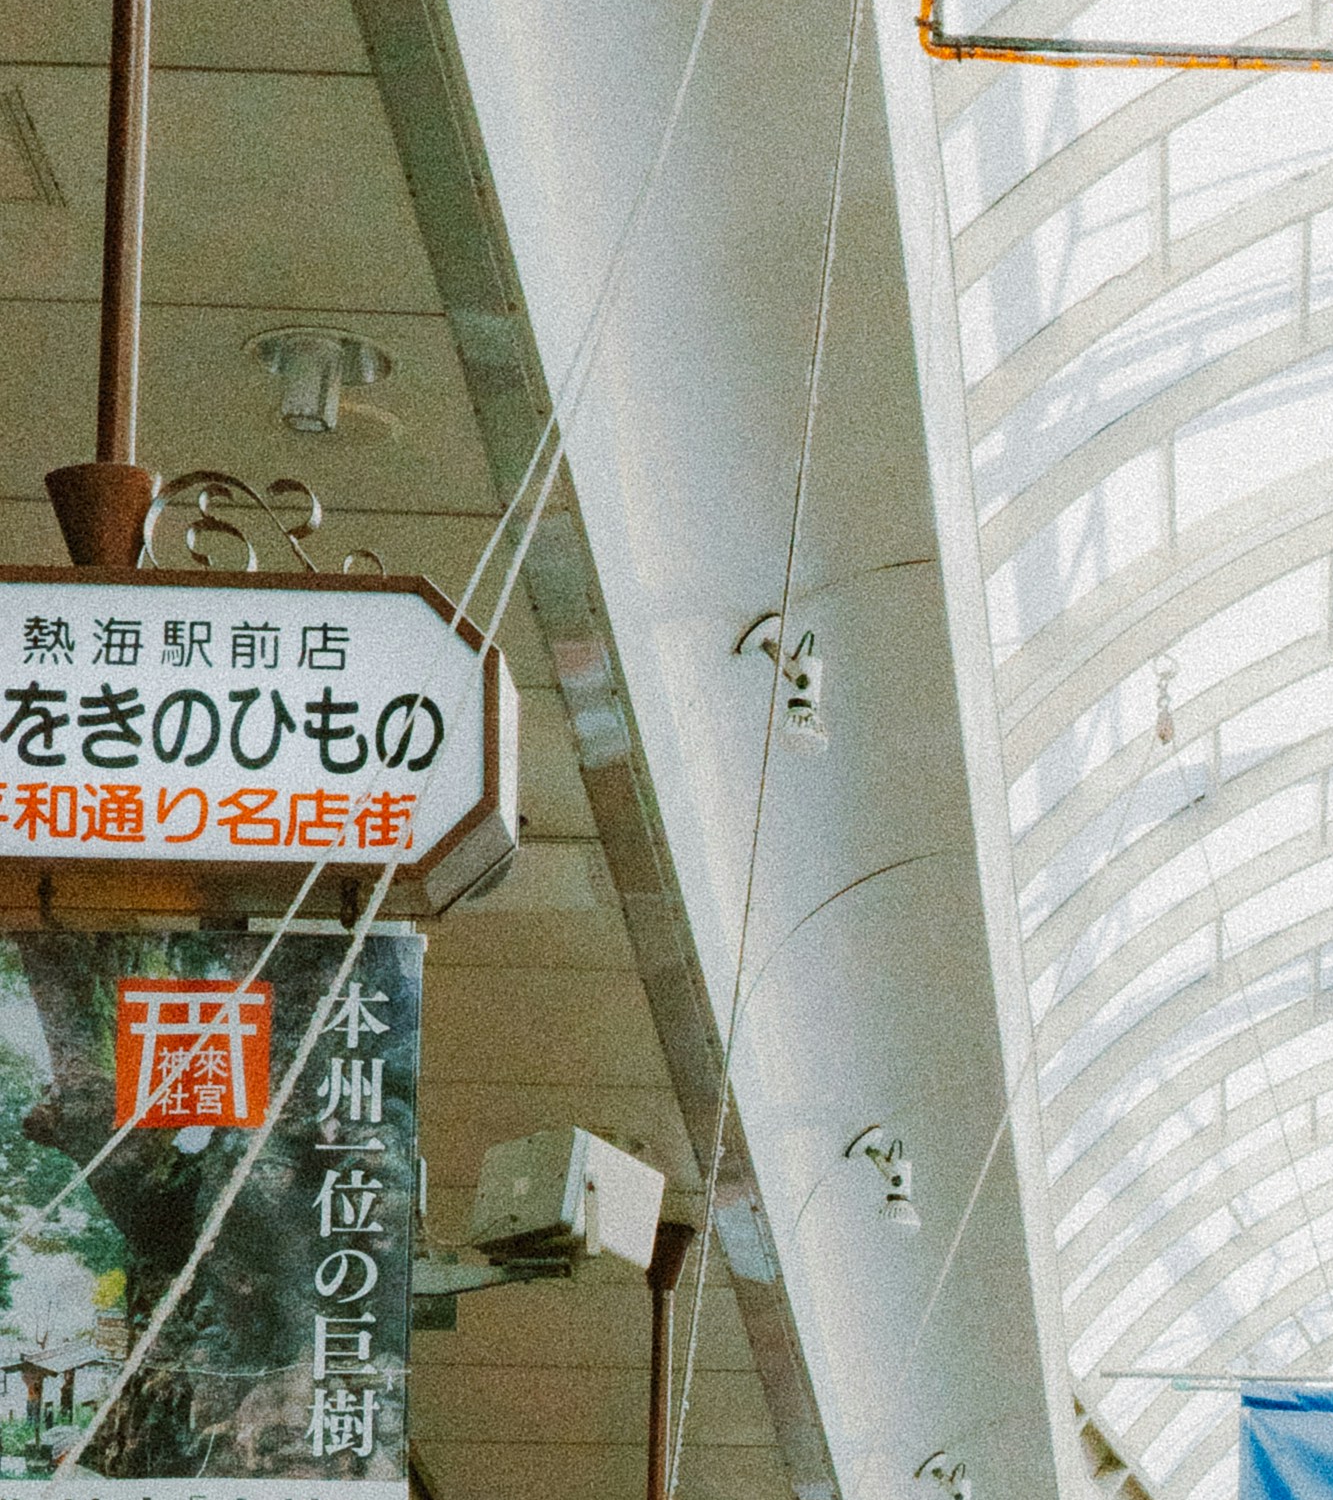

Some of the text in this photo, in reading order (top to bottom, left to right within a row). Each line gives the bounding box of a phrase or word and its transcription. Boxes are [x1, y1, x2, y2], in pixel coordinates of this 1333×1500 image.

[21, 615, 351, 673] 熱海駅前店
[0, 781, 416, 853] 和通り名店街
[305, 982, 391, 1459] 本州一位の巨樹
